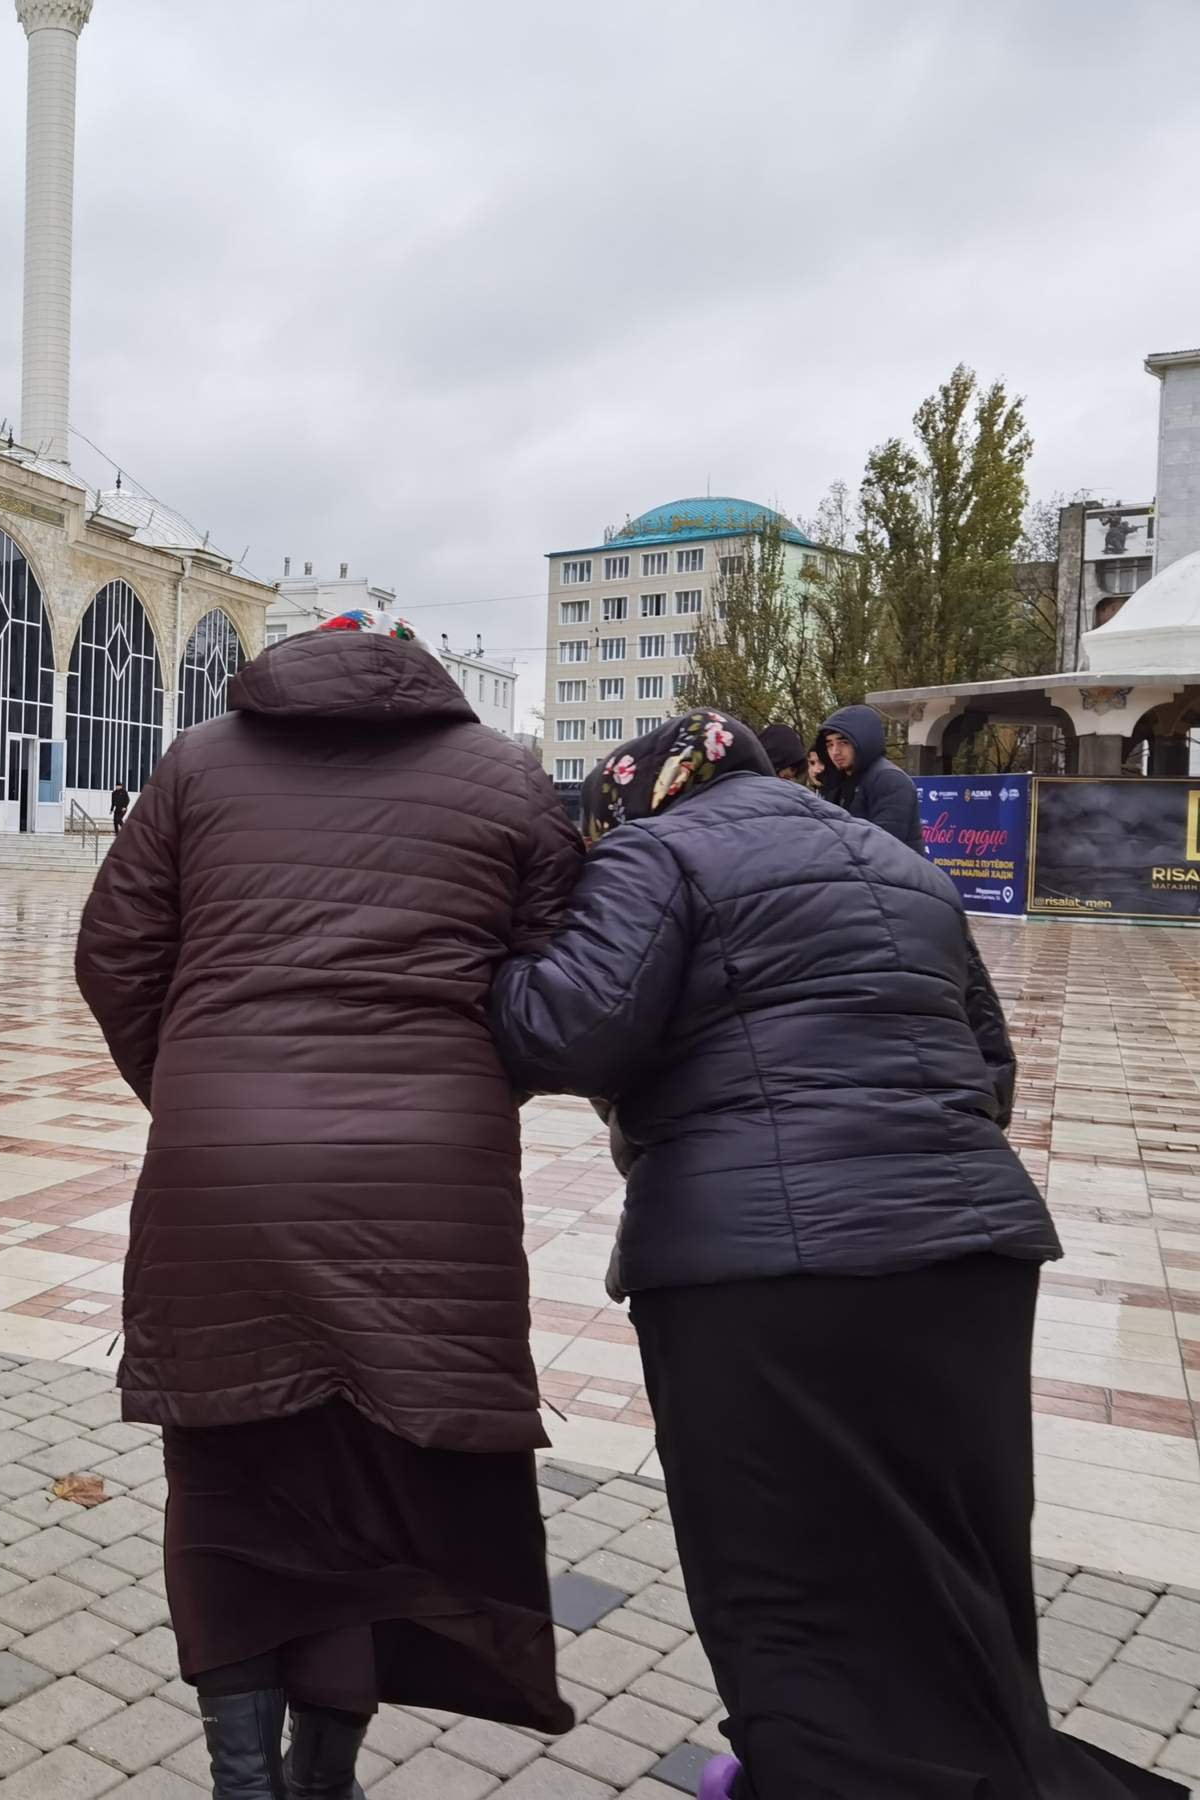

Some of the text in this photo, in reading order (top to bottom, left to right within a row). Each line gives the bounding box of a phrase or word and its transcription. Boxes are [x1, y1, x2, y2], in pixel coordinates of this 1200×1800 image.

[958, 828, 1008, 856] сердце
[950, 868, 961, 877] НА
[1152, 867, 1200, 881] RISA
[1152, 882, 1198, 890] МАГАЗИН
[1034, 896, 1112, 910] @risalat_men
